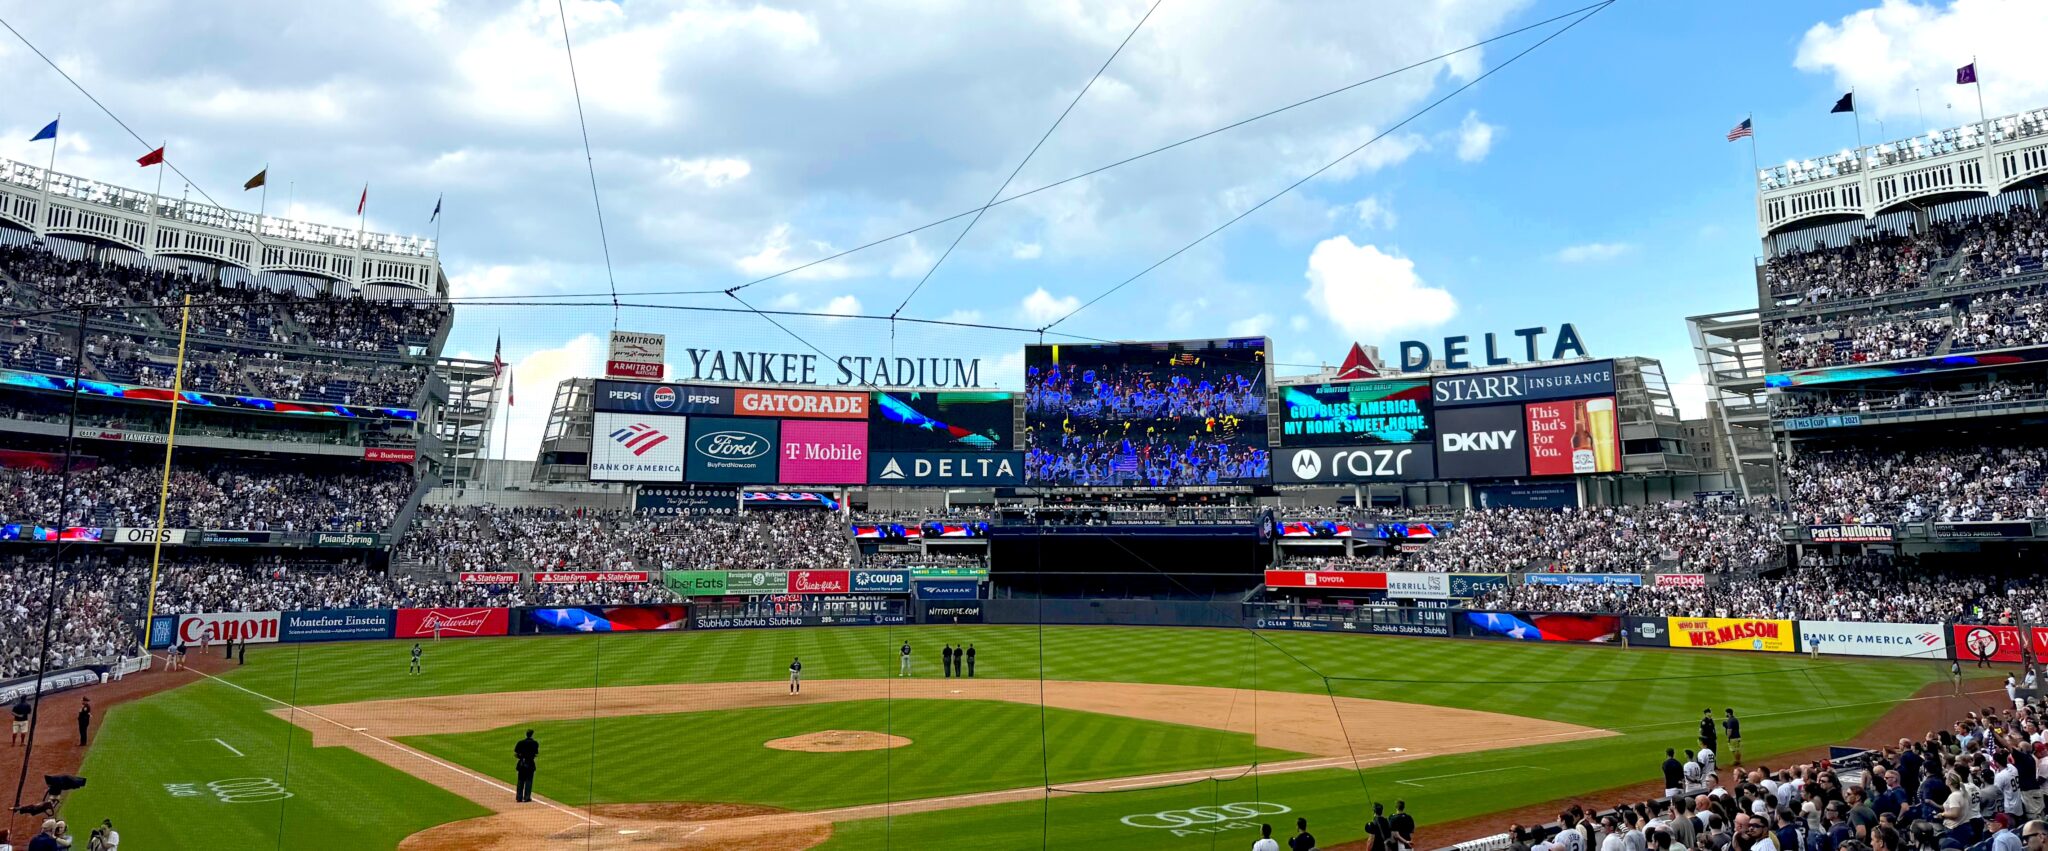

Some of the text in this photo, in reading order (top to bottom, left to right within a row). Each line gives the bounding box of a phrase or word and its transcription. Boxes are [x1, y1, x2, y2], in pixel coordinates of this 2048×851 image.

[612, 335, 663, 345] ARMITRON
[1400, 323, 1589, 373] DELTA
[613, 363, 659, 371] ARMITRON
[686, 348, 981, 388] YANKEE STADIUM
[1435, 371, 1610, 402] STARR INSURANCE
[609, 390, 720, 404] PEPSI PEPSI PEPSI
[742, 393, 862, 413] GATORADE
[1290, 399, 1421, 418] GOD BLESS AMERICA,
[1530, 406, 1559, 419] This
[1285, 415, 1429, 435] MY HOME SWEET HOME.
[1531, 419, 1567, 432] Bud's
[1813, 419, 1825, 427] CUP
[1845, 416, 1858, 424] 2021
[99, 431, 122, 439] Audi
[125, 433, 153, 442] YANKEES
[1442, 430, 1517, 452] DKNY
[1532, 433, 1554, 445] For
[708, 433, 758, 456] Ford
[786, 442, 862, 460] T Mobile
[380, 450, 414, 459] Budweiser
[1533, 446, 1562, 457] You.
[592, 463, 620, 471] BANK
[636, 464, 680, 472] AMERICA
[707, 461, 757, 469] BuyFordNow.com
[914, 458, 1015, 478] DELTA
[1332, 449, 1412, 477] razr
[1811, 525, 1892, 538] Parts Authority
[319, 534, 372, 546] Poland Spring
[667, 575, 724, 589] Uber Eats
[870, 573, 903, 586] coupa
[1318, 575, 1345, 583] TOYOTA
[1656, 574, 1705, 585] Reebok
[1389, 582, 1427, 590] MERRILL
[289, 614, 386, 627] Montefiore Einstein
[423, 616, 483, 628] Budweiser
[698, 619, 730, 628] StubHub
[733, 618, 766, 626] StubHub
[769, 617, 802, 626] StubHub
[1678, 622, 1693, 630] WHO
[180, 617, 277, 643] Canon
[1373, 624, 1397, 632] StubHub
[1400, 625, 1422, 633] StubHub
[1423, 626, 1447, 635] StubHub
[1838, 634, 1853, 642] OF
[1856, 635, 1913, 645] AMERICA
